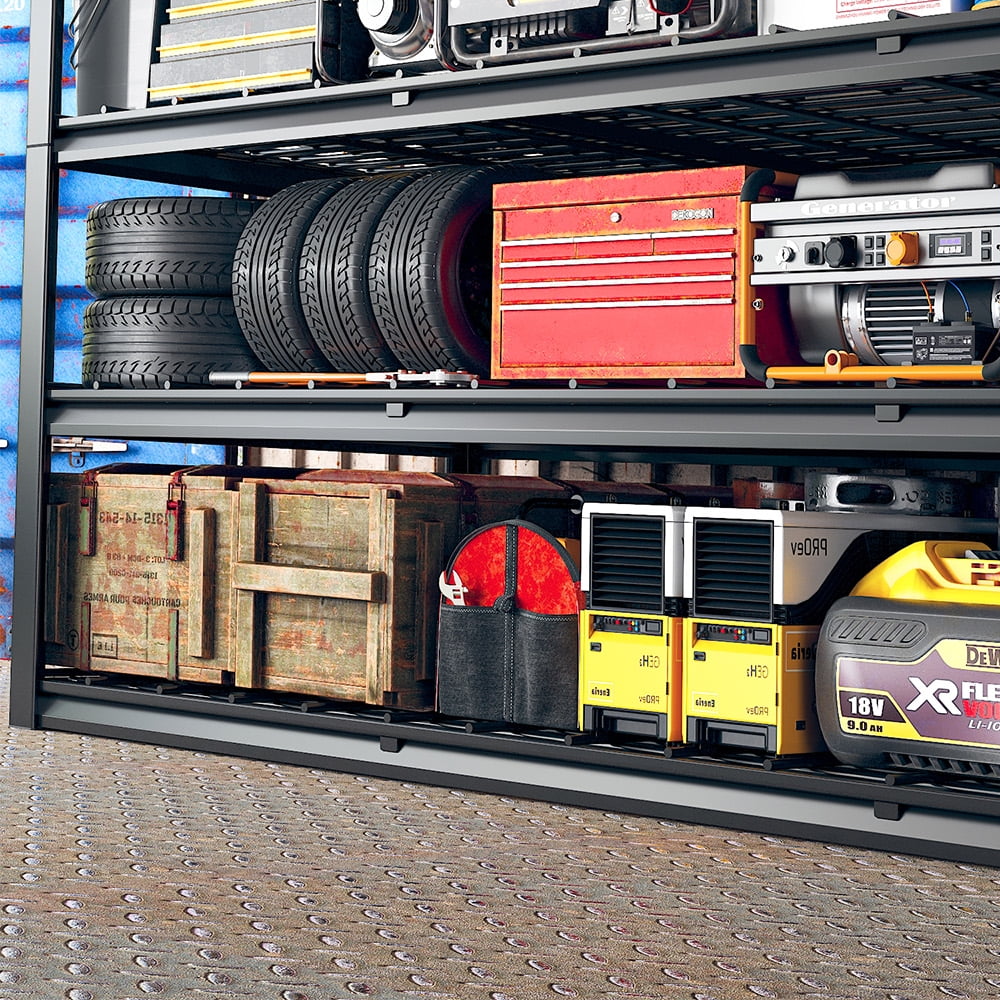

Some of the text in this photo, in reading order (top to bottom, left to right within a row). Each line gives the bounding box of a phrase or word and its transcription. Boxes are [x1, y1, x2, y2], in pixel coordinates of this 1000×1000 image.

[800, 196, 956, 216] Generator
[906, 676, 963, 716] XR
[848, 696, 885, 717] 18V
[847, 721, 868, 732] 9.0
